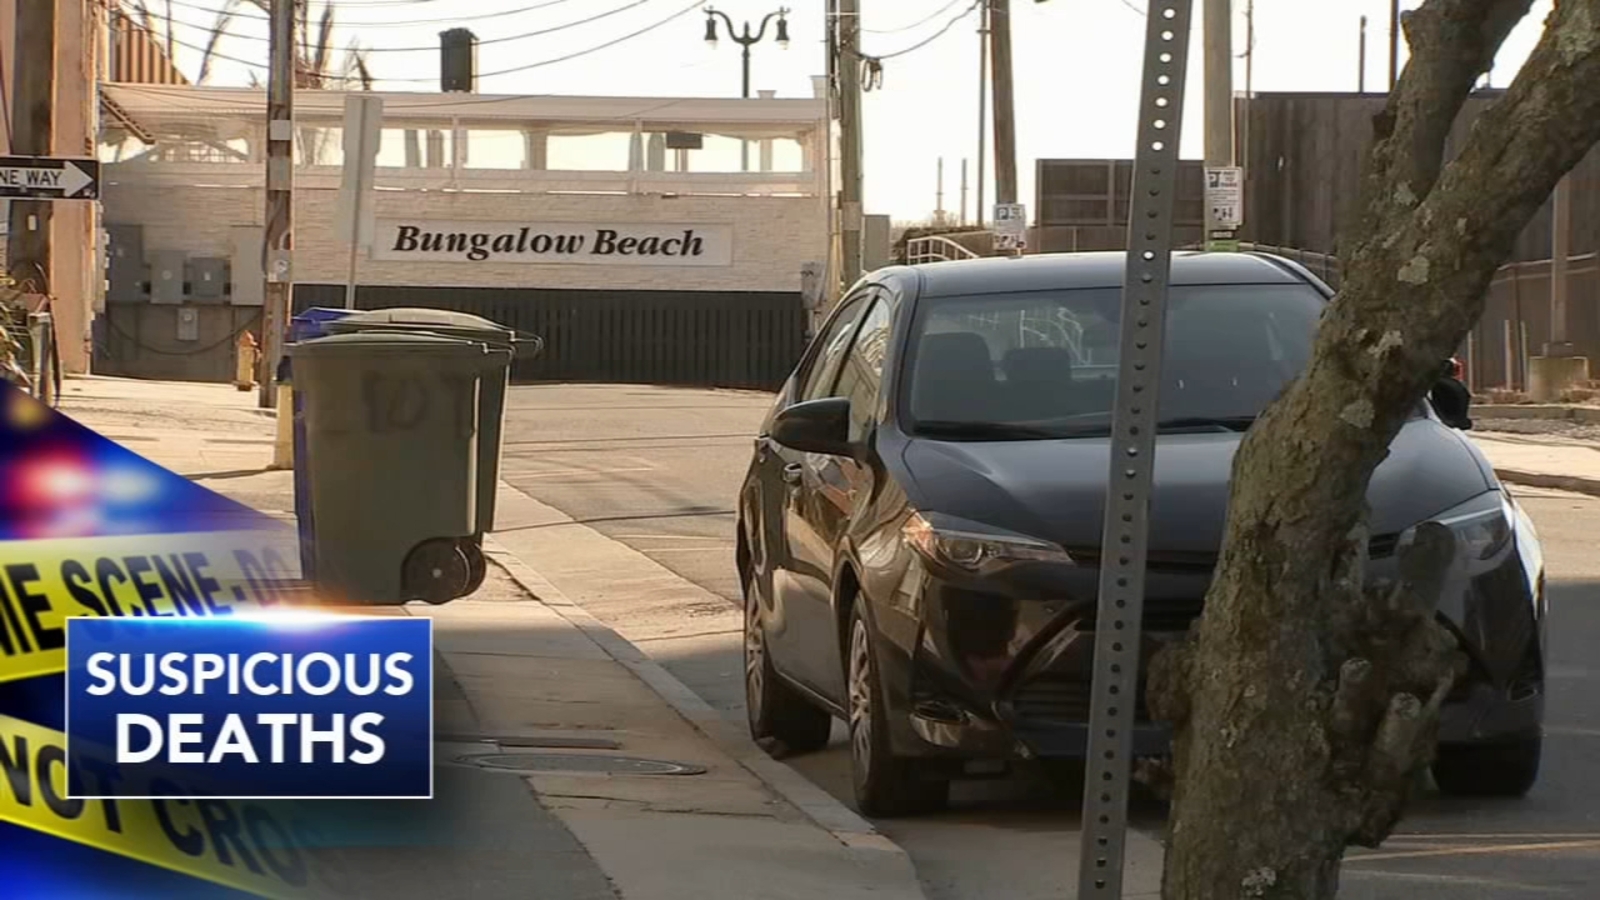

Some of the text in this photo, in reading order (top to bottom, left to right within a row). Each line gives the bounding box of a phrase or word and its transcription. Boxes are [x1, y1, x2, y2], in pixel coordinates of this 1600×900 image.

[26, 170, 61, 186] WAY
[393, 226, 704, 261] Bungalow Beach
